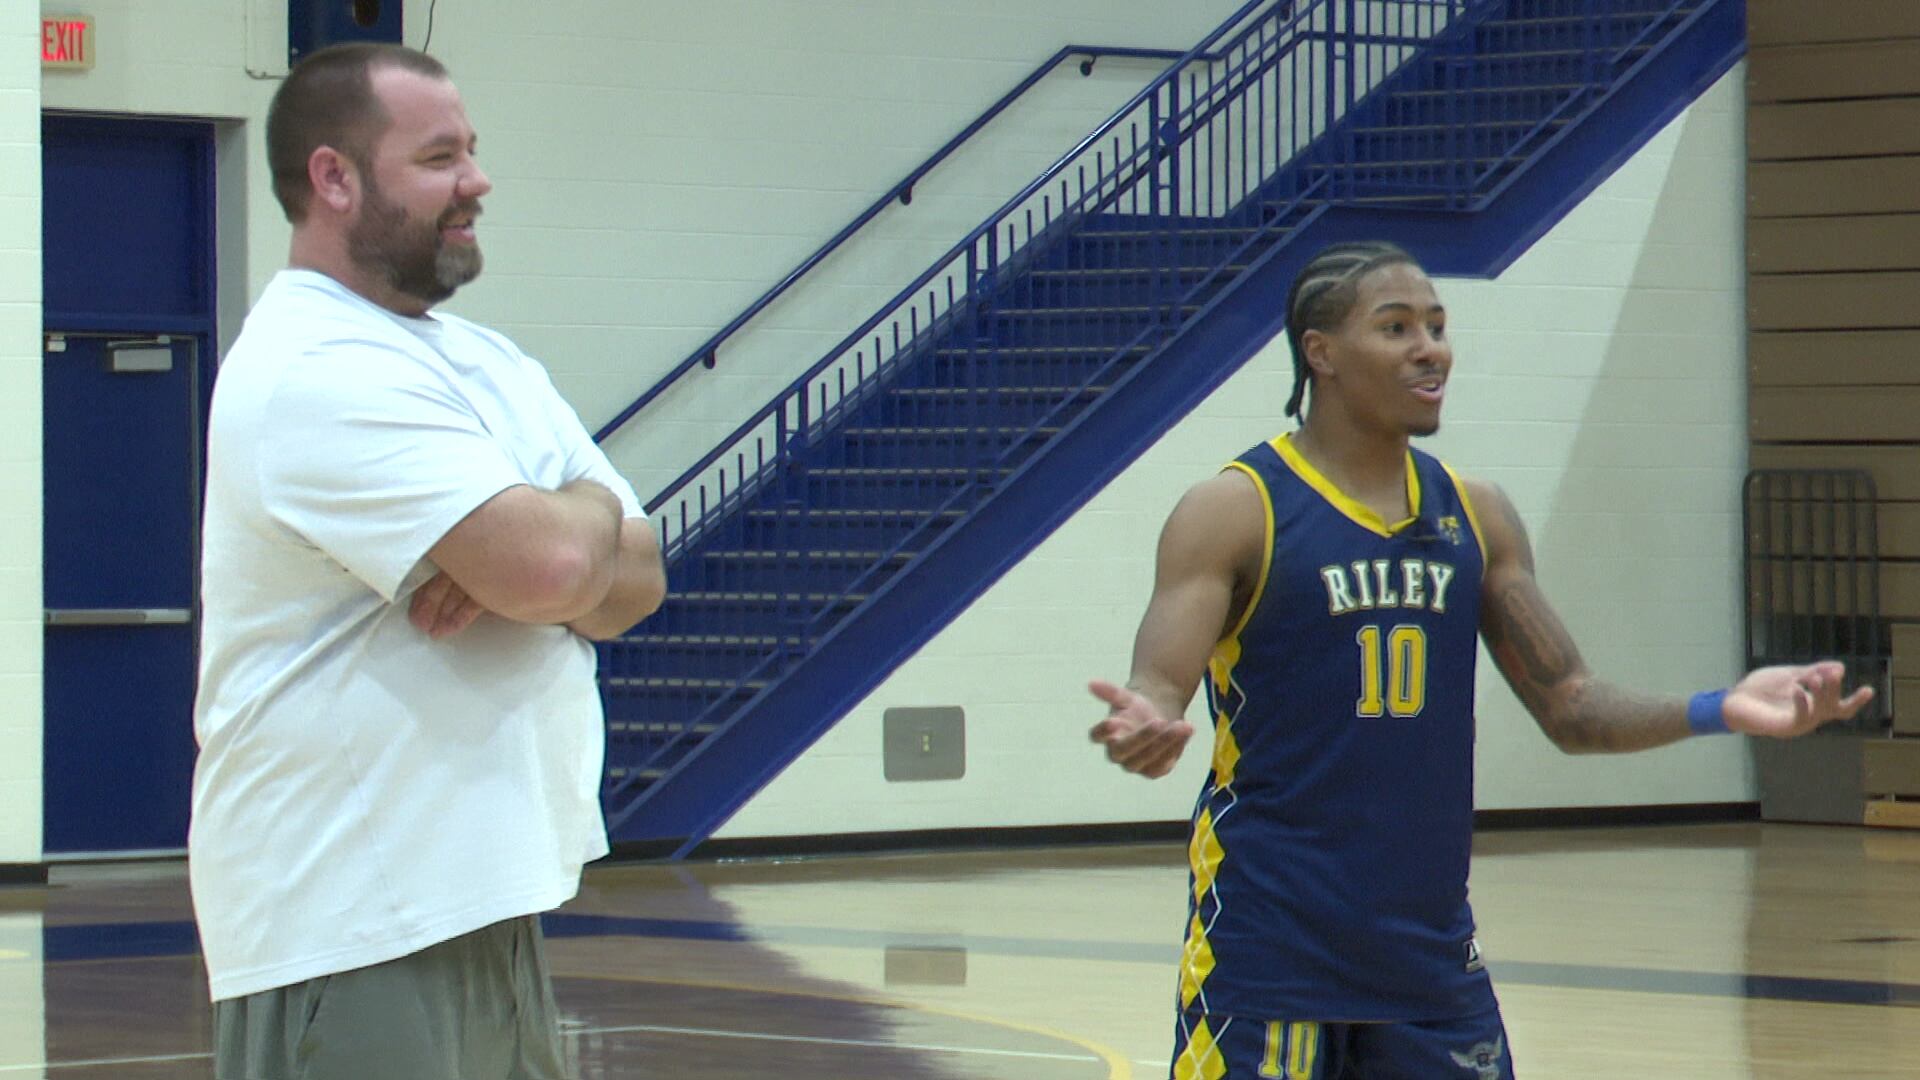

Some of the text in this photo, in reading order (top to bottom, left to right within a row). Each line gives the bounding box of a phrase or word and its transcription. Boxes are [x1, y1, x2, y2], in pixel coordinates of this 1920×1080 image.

[42, 20, 86, 62] EXIT
[1320, 558, 1455, 616] RILEY
[1356, 625, 1427, 718] 10
[1257, 1020, 1320, 1080] 10
